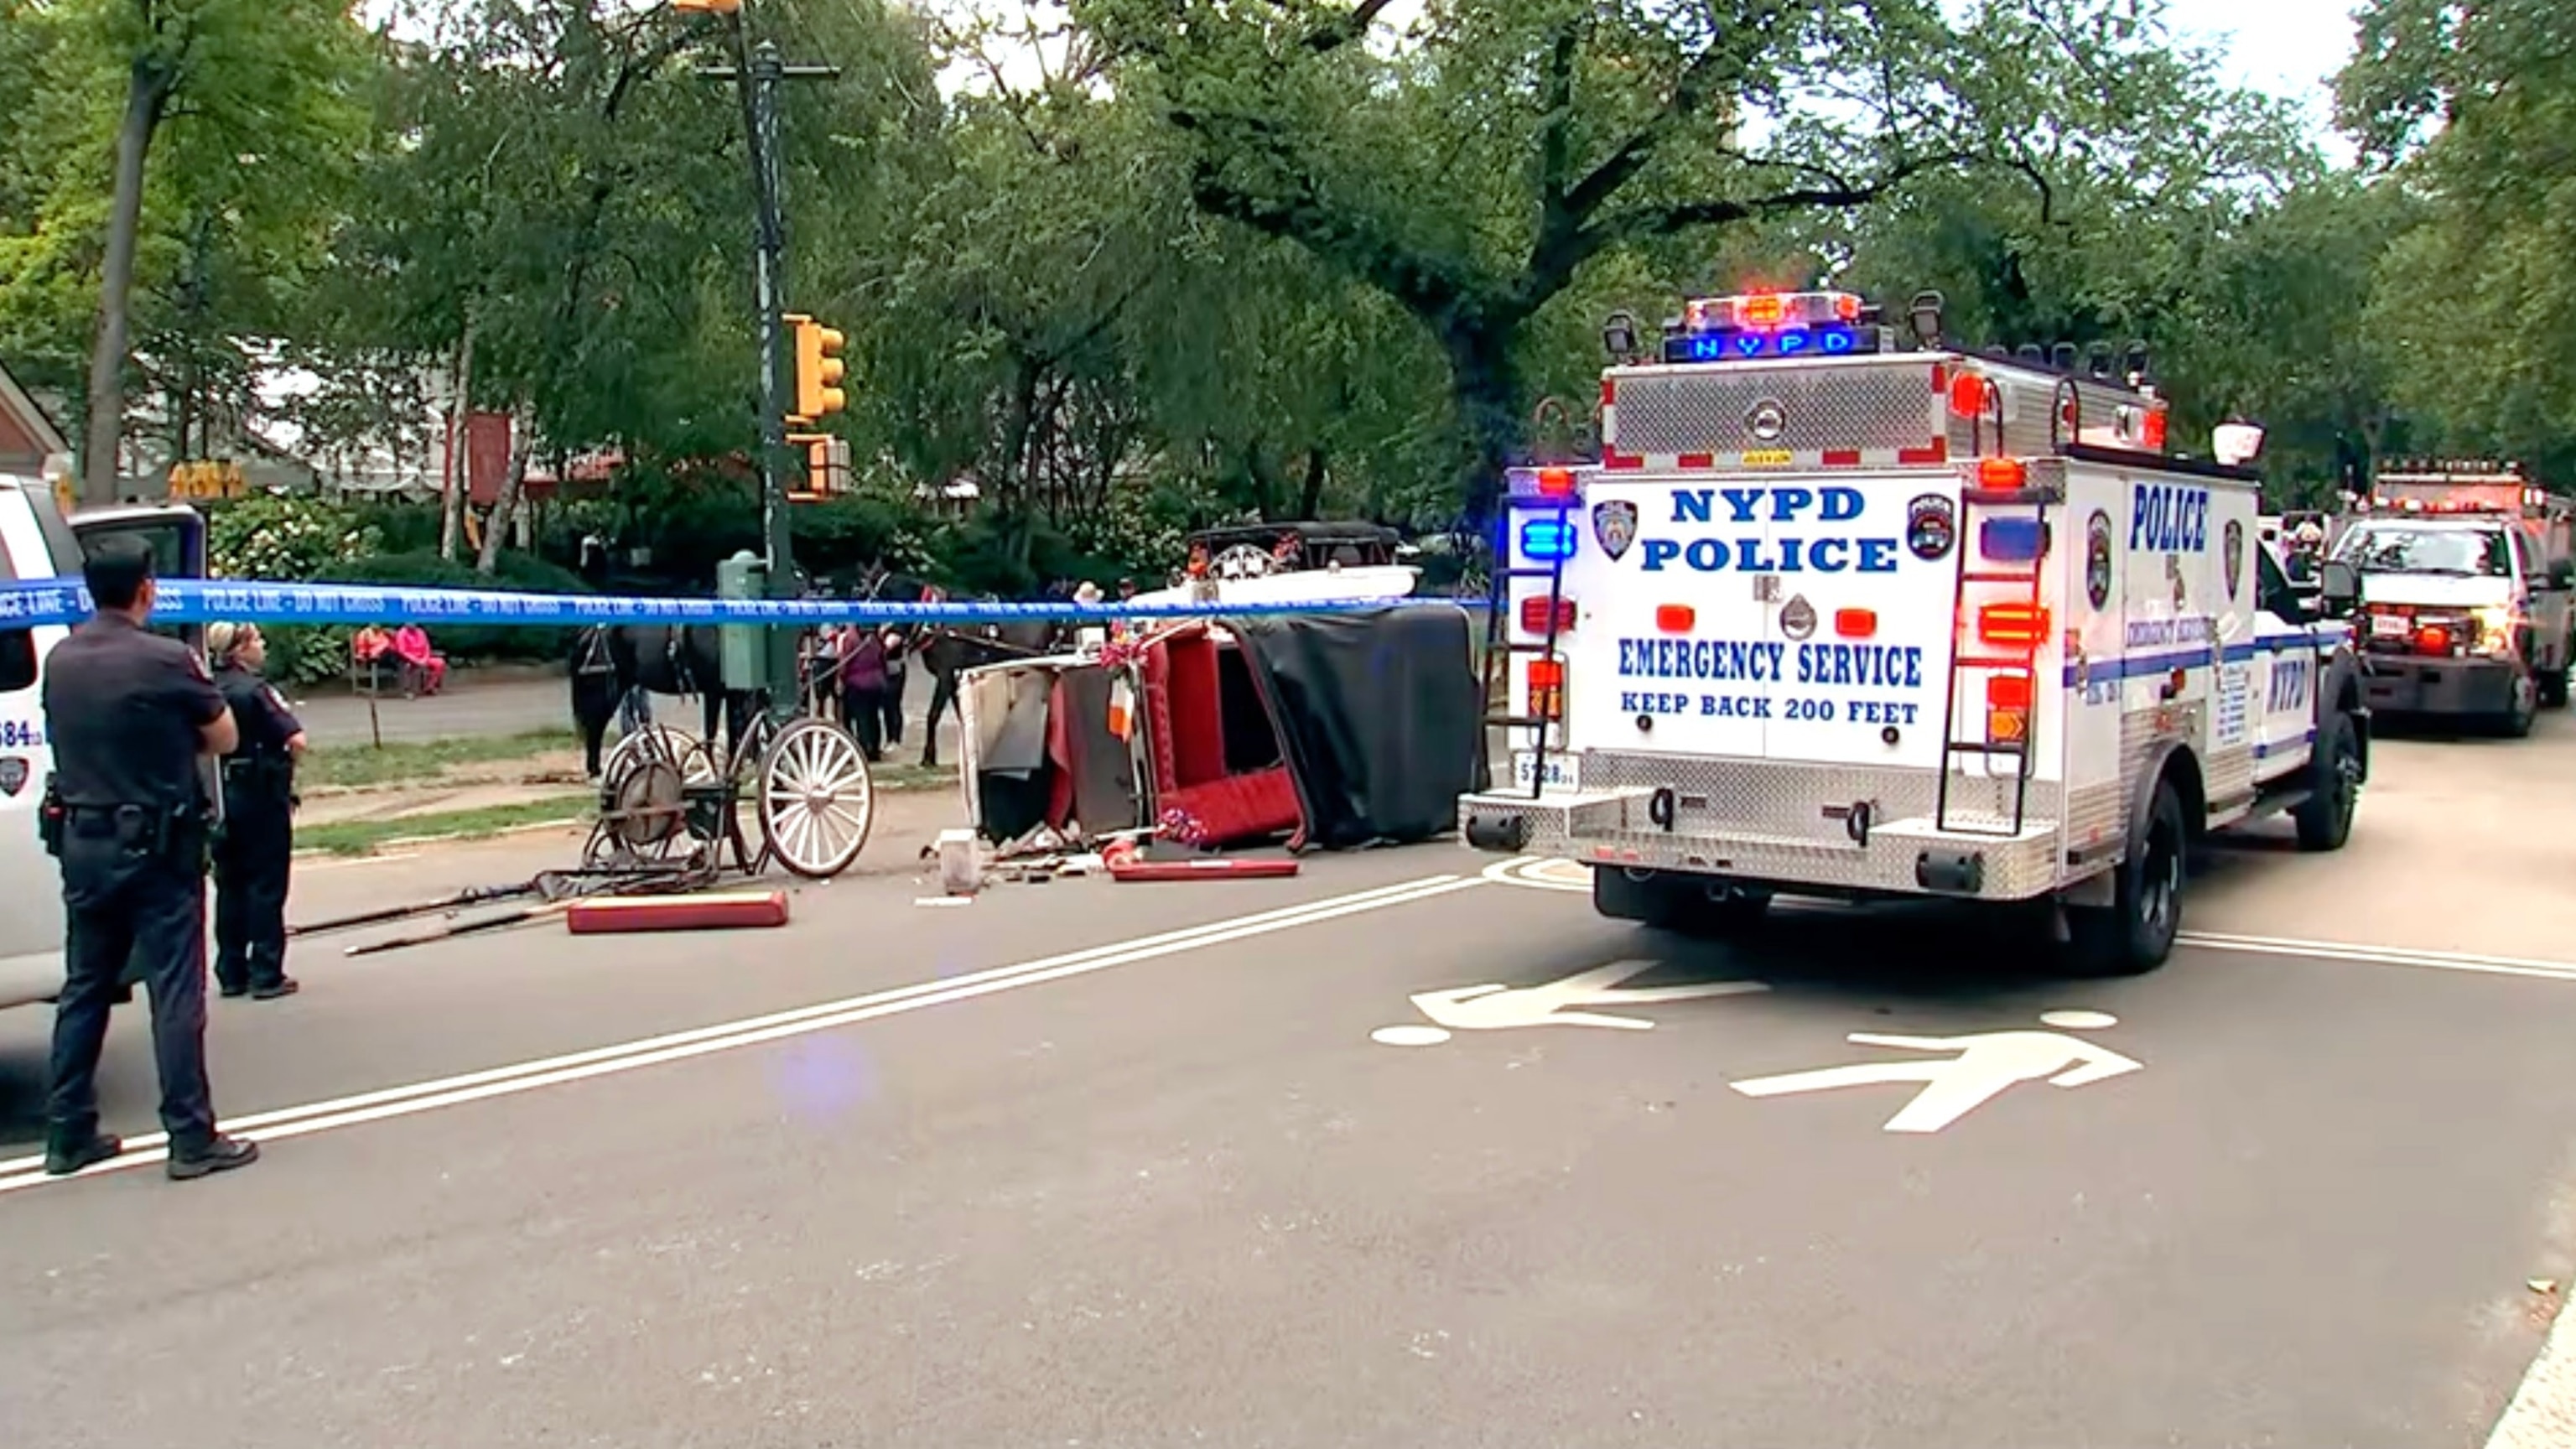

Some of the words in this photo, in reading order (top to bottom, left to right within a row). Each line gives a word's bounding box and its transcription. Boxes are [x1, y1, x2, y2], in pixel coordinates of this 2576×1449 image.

[1696, 331, 1849, 357] NYPD
[1671, 487, 1865, 522] NYPD
[2131, 484, 2209, 552] POLICE
[1641, 538, 1898, 572] POLICE
[1618, 638, 1785, 682] EMERGENCY
[1799, 643, 1922, 688] SERVICE
[1621, 692, 1689, 714] KEEP
[1701, 696, 1772, 719] BACK
[1784, 699, 1835, 721] 200
[1848, 701, 1919, 724] FEET
[0, 720, 31, 747] 84
